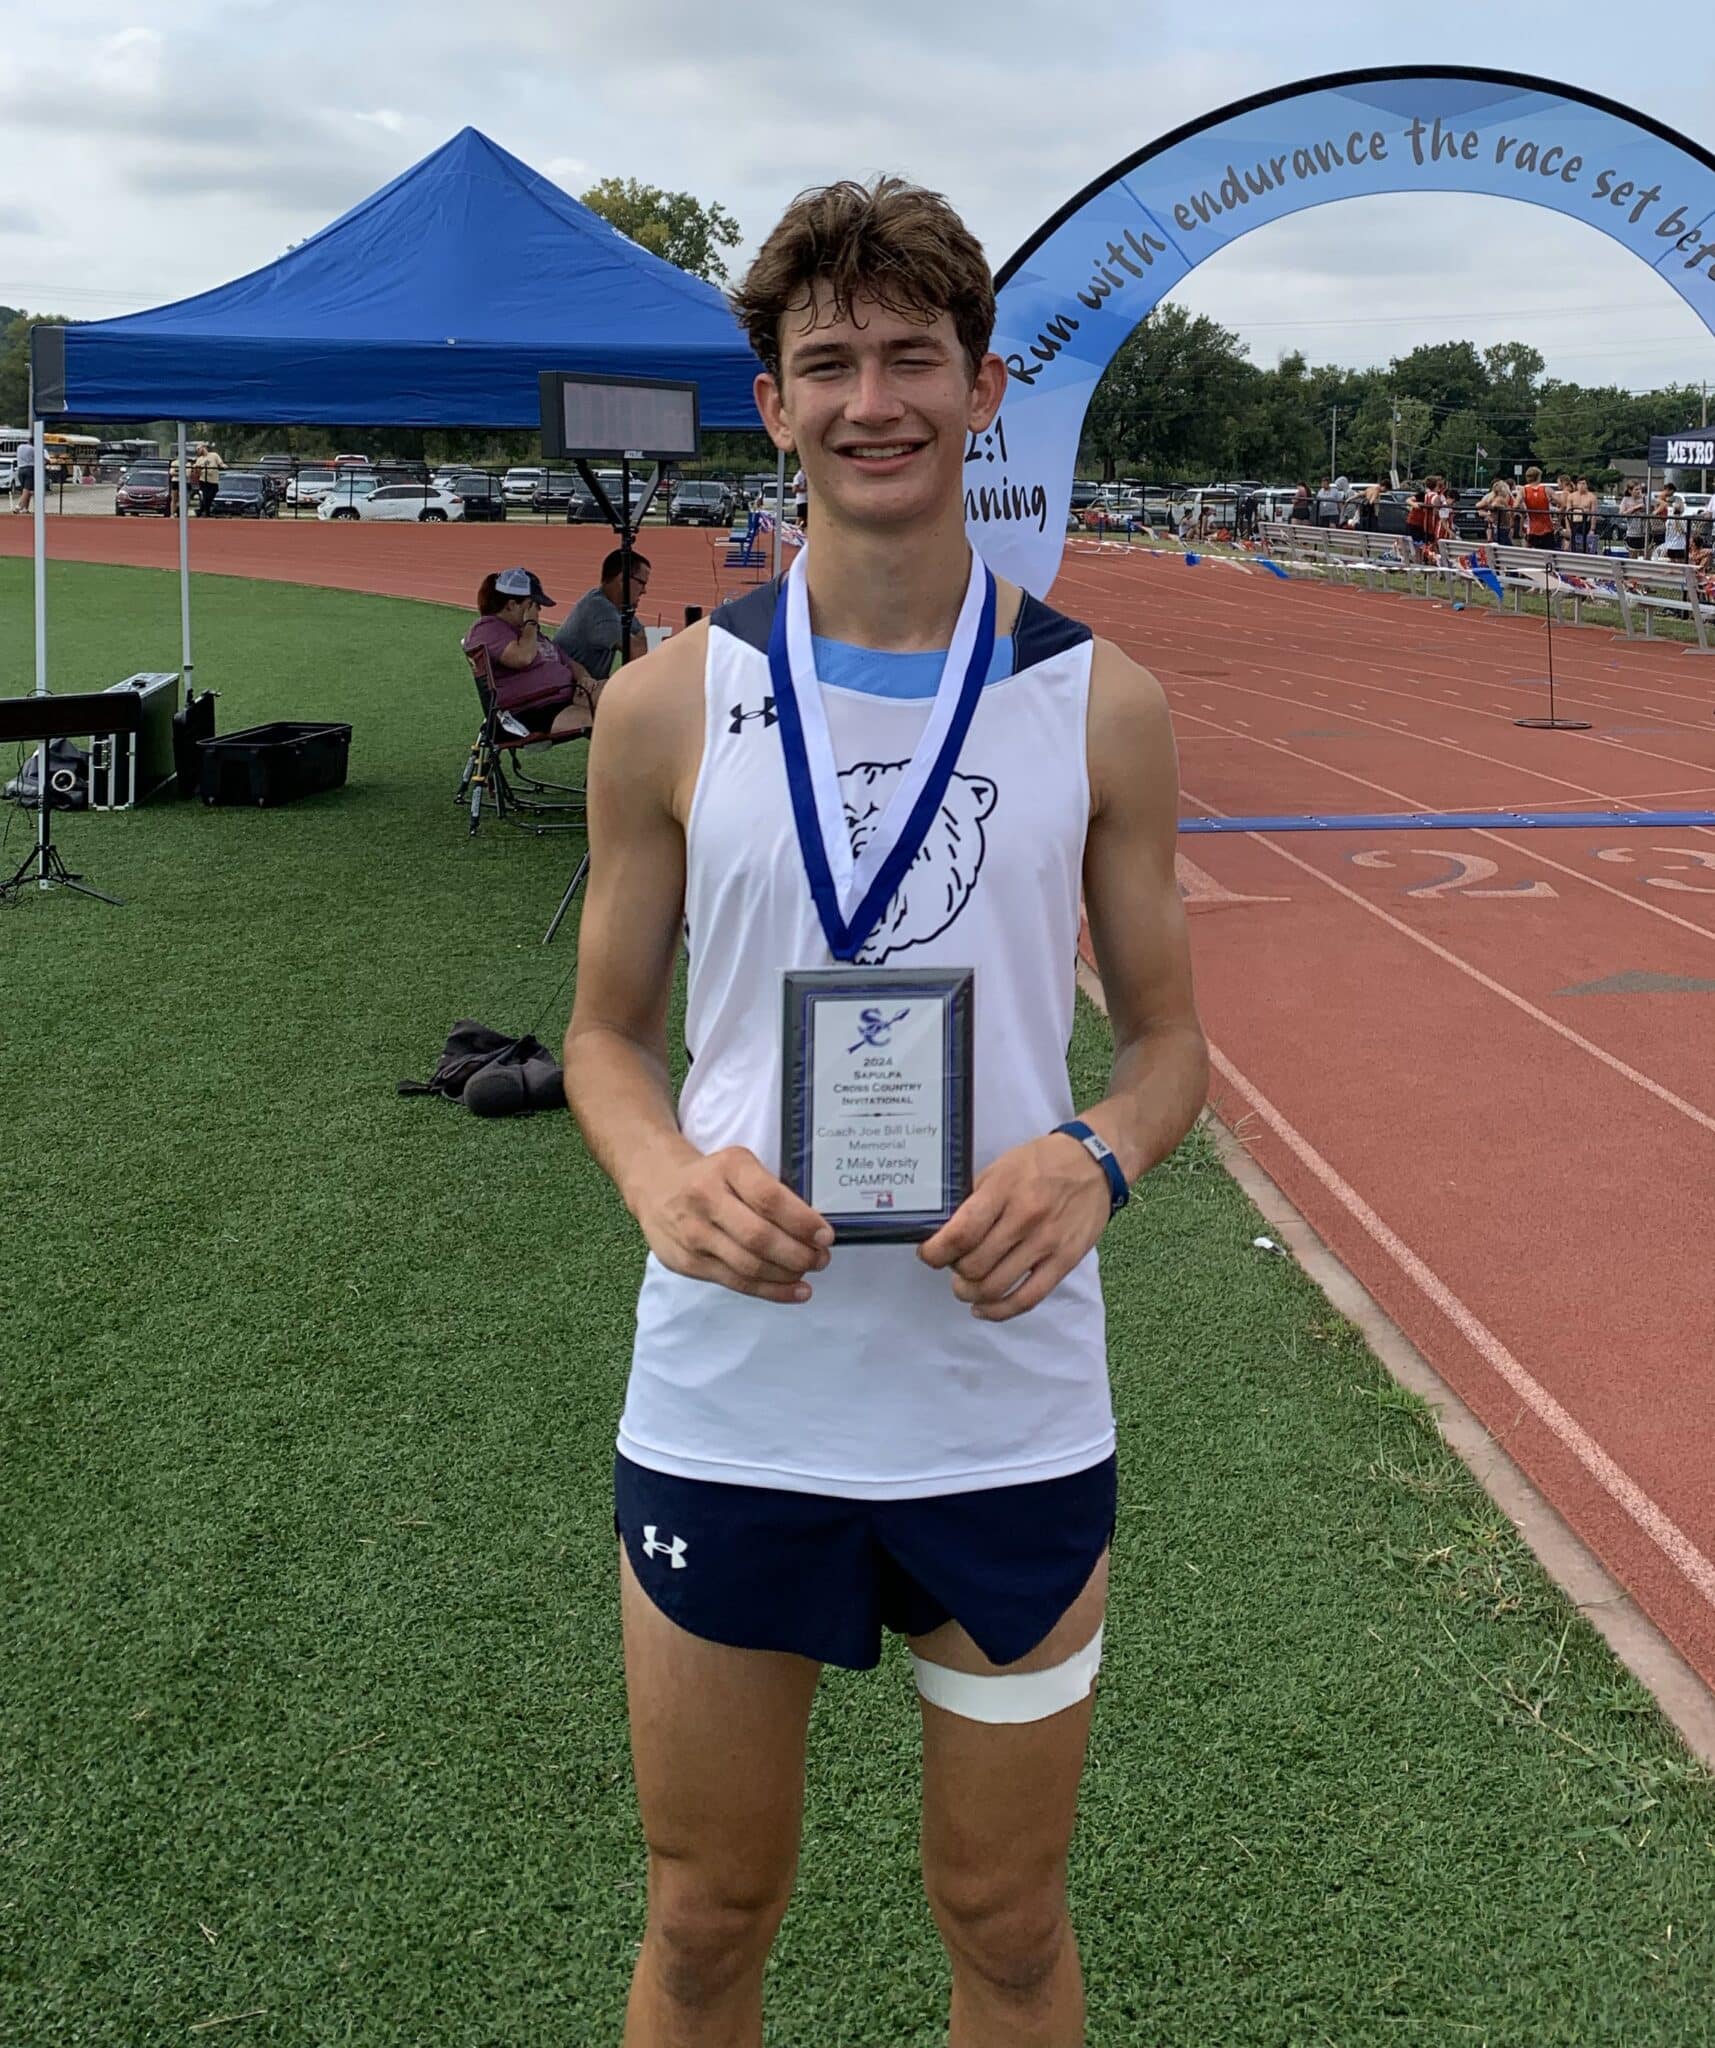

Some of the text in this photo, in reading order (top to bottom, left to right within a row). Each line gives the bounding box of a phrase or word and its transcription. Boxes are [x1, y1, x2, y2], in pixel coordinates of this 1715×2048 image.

[1005, 313, 1080, 385] Run
[1077, 229, 1167, 310] with
[1174, 131, 1389, 231] endurance
[1403, 116, 1479, 166] the
[1495, 135, 1583, 183] race
[1592, 169, 1662, 223] set
[1666, 440, 1714, 465] METRO
[1350, 848, 1560, 899] 2
[863, 1057, 893, 1067] 2024
[872, 1082, 922, 1093] COUNTRY
[841, 1096, 913, 1106] INVITATIONAL
[816, 1126, 856, 1138] Coach
[859, 1126, 881, 1137] Joe
[884, 1125, 902, 1137] Bill
[849, 1138, 906, 1151] Memorial
[835, 1156, 919, 1170] 2 Mile Varsity
[838, 1172, 915, 1187] CHAMPION
